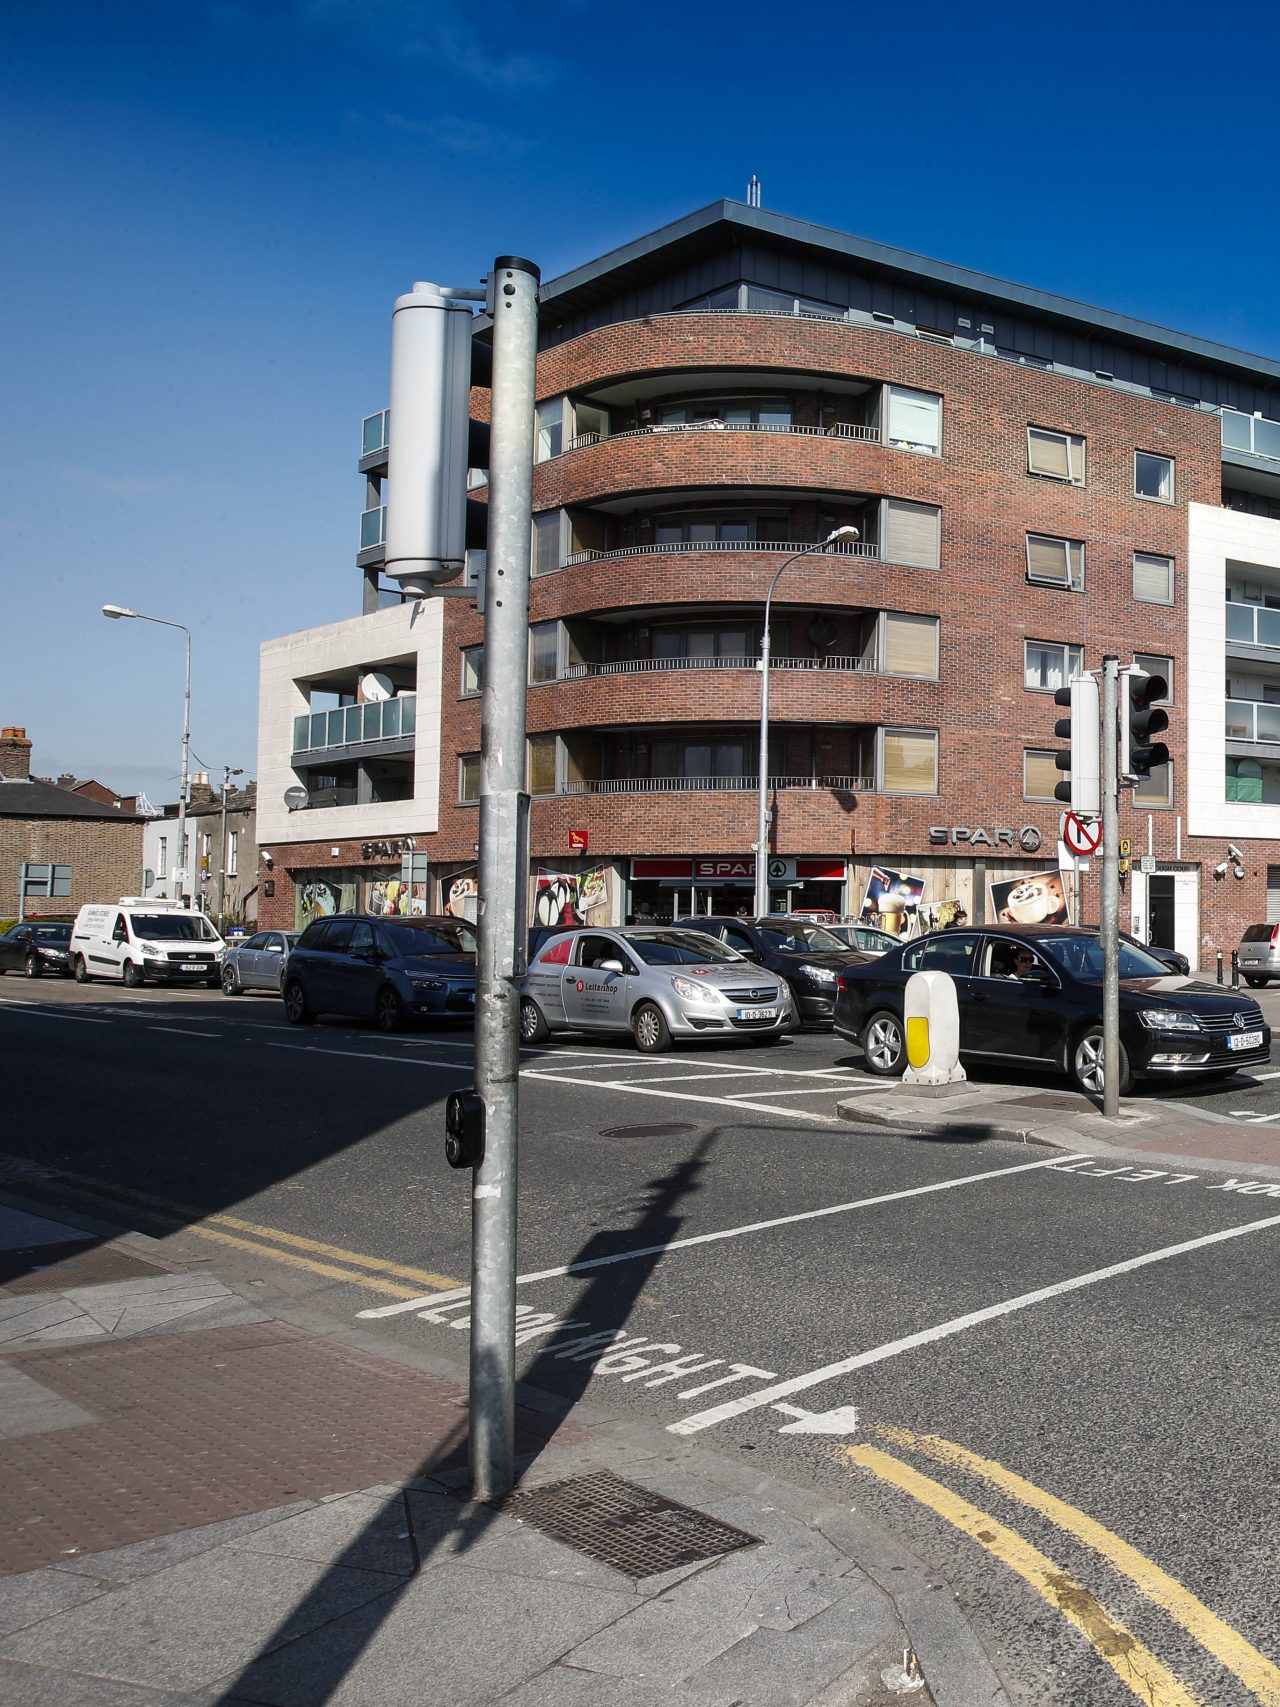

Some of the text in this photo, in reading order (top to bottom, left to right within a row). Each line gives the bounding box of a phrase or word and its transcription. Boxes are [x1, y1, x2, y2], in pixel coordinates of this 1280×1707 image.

[929, 826, 1013, 848] SPAR
[585, 982, 618, 995] Lettershop
[1045, 1160, 1200, 1185] LEFT
[539, 1327, 779, 1400] RIGHT
